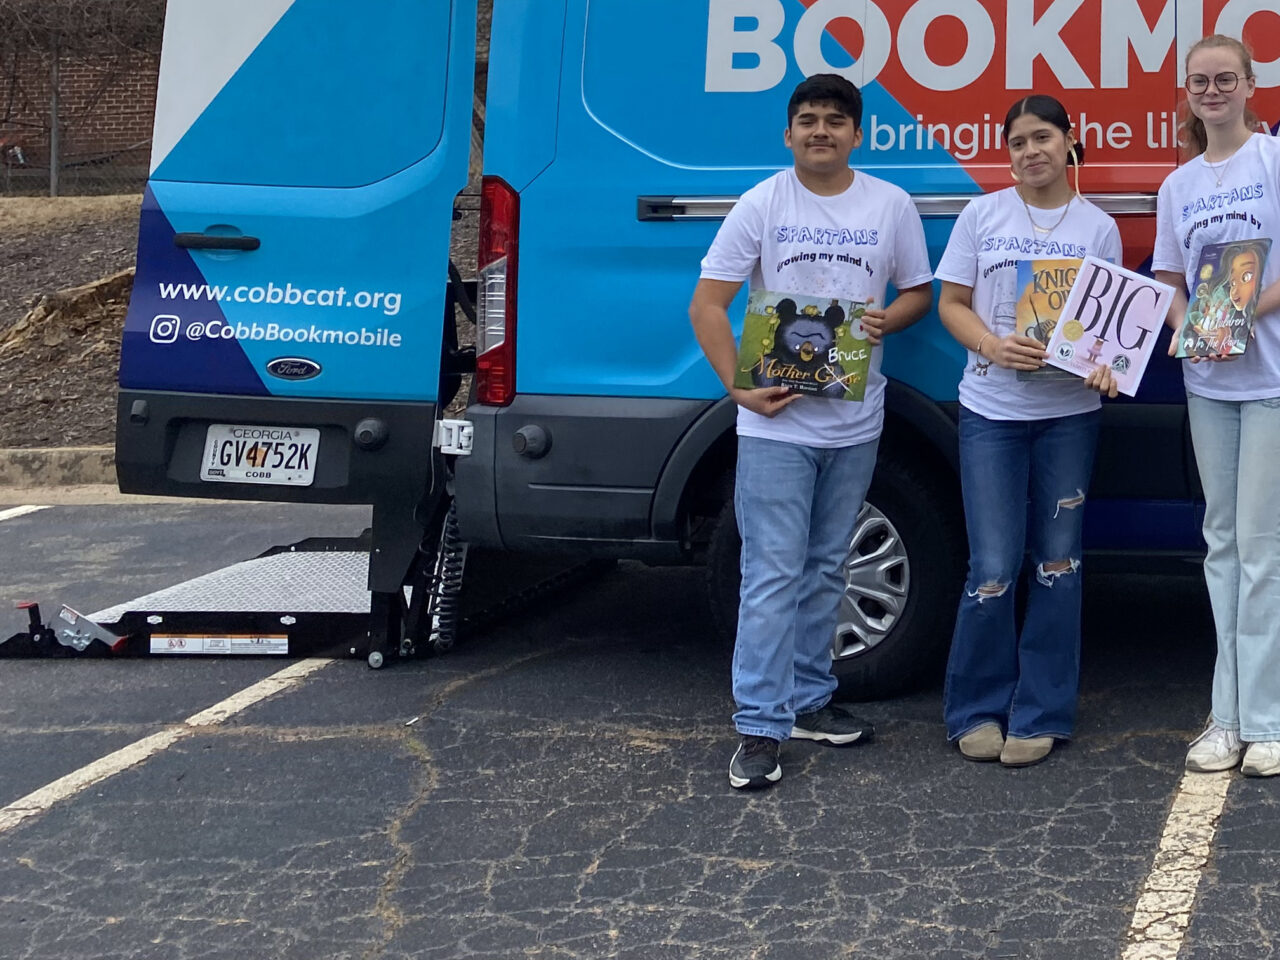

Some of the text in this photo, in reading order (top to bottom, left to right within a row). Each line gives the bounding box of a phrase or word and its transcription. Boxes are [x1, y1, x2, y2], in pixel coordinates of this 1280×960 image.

[870, 113, 1005, 160] bringi
[1072, 113, 1132, 148] he
[1211, 215, 1224, 223] my
[1226, 211, 1247, 221] mind
[1251, 214, 1261, 230] by
[777, 226, 878, 246] SPARTANS
[984, 237, 1086, 258] SPARTANS
[819, 253, 834, 262] my
[837, 253, 861, 266] mind
[866, 261, 873, 277] by
[159, 282, 402, 315] www.cobbcat.org
[1074, 263, 1162, 351] BIG
[186, 321, 402, 347] @CobbBookmobile
[741, 354, 810, 379] Mother
[233, 428, 292, 441] GEORGIA
[220, 440, 312, 470] GV4752K
